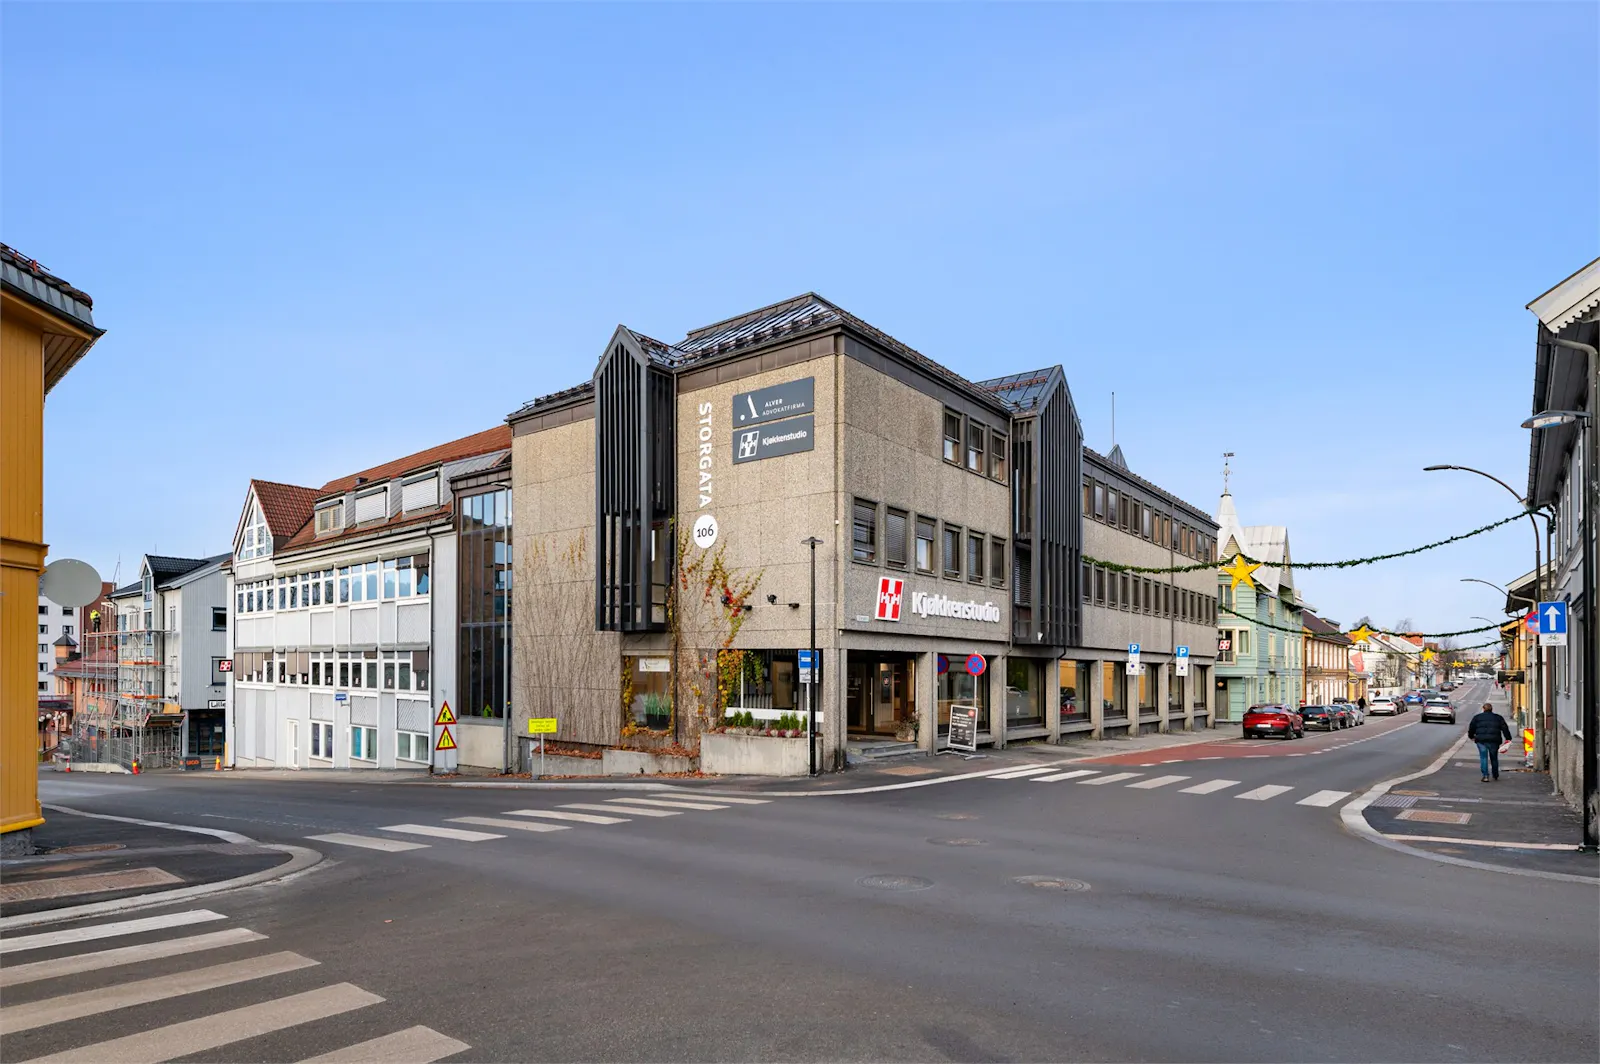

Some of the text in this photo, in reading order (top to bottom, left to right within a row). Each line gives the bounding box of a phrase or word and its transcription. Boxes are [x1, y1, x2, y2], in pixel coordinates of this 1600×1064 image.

[762, 402, 805, 416] ADVOKATFIRMA
[764, 398, 783, 408] ALVER
[762, 430, 807, 446] Kjøkkenstudio
[698, 402, 713, 508] STORGATA
[697, 524, 714, 538] 106
[880, 591, 901, 605] HTH
[911, 591, 1000, 623] Kjøkkenstudio
